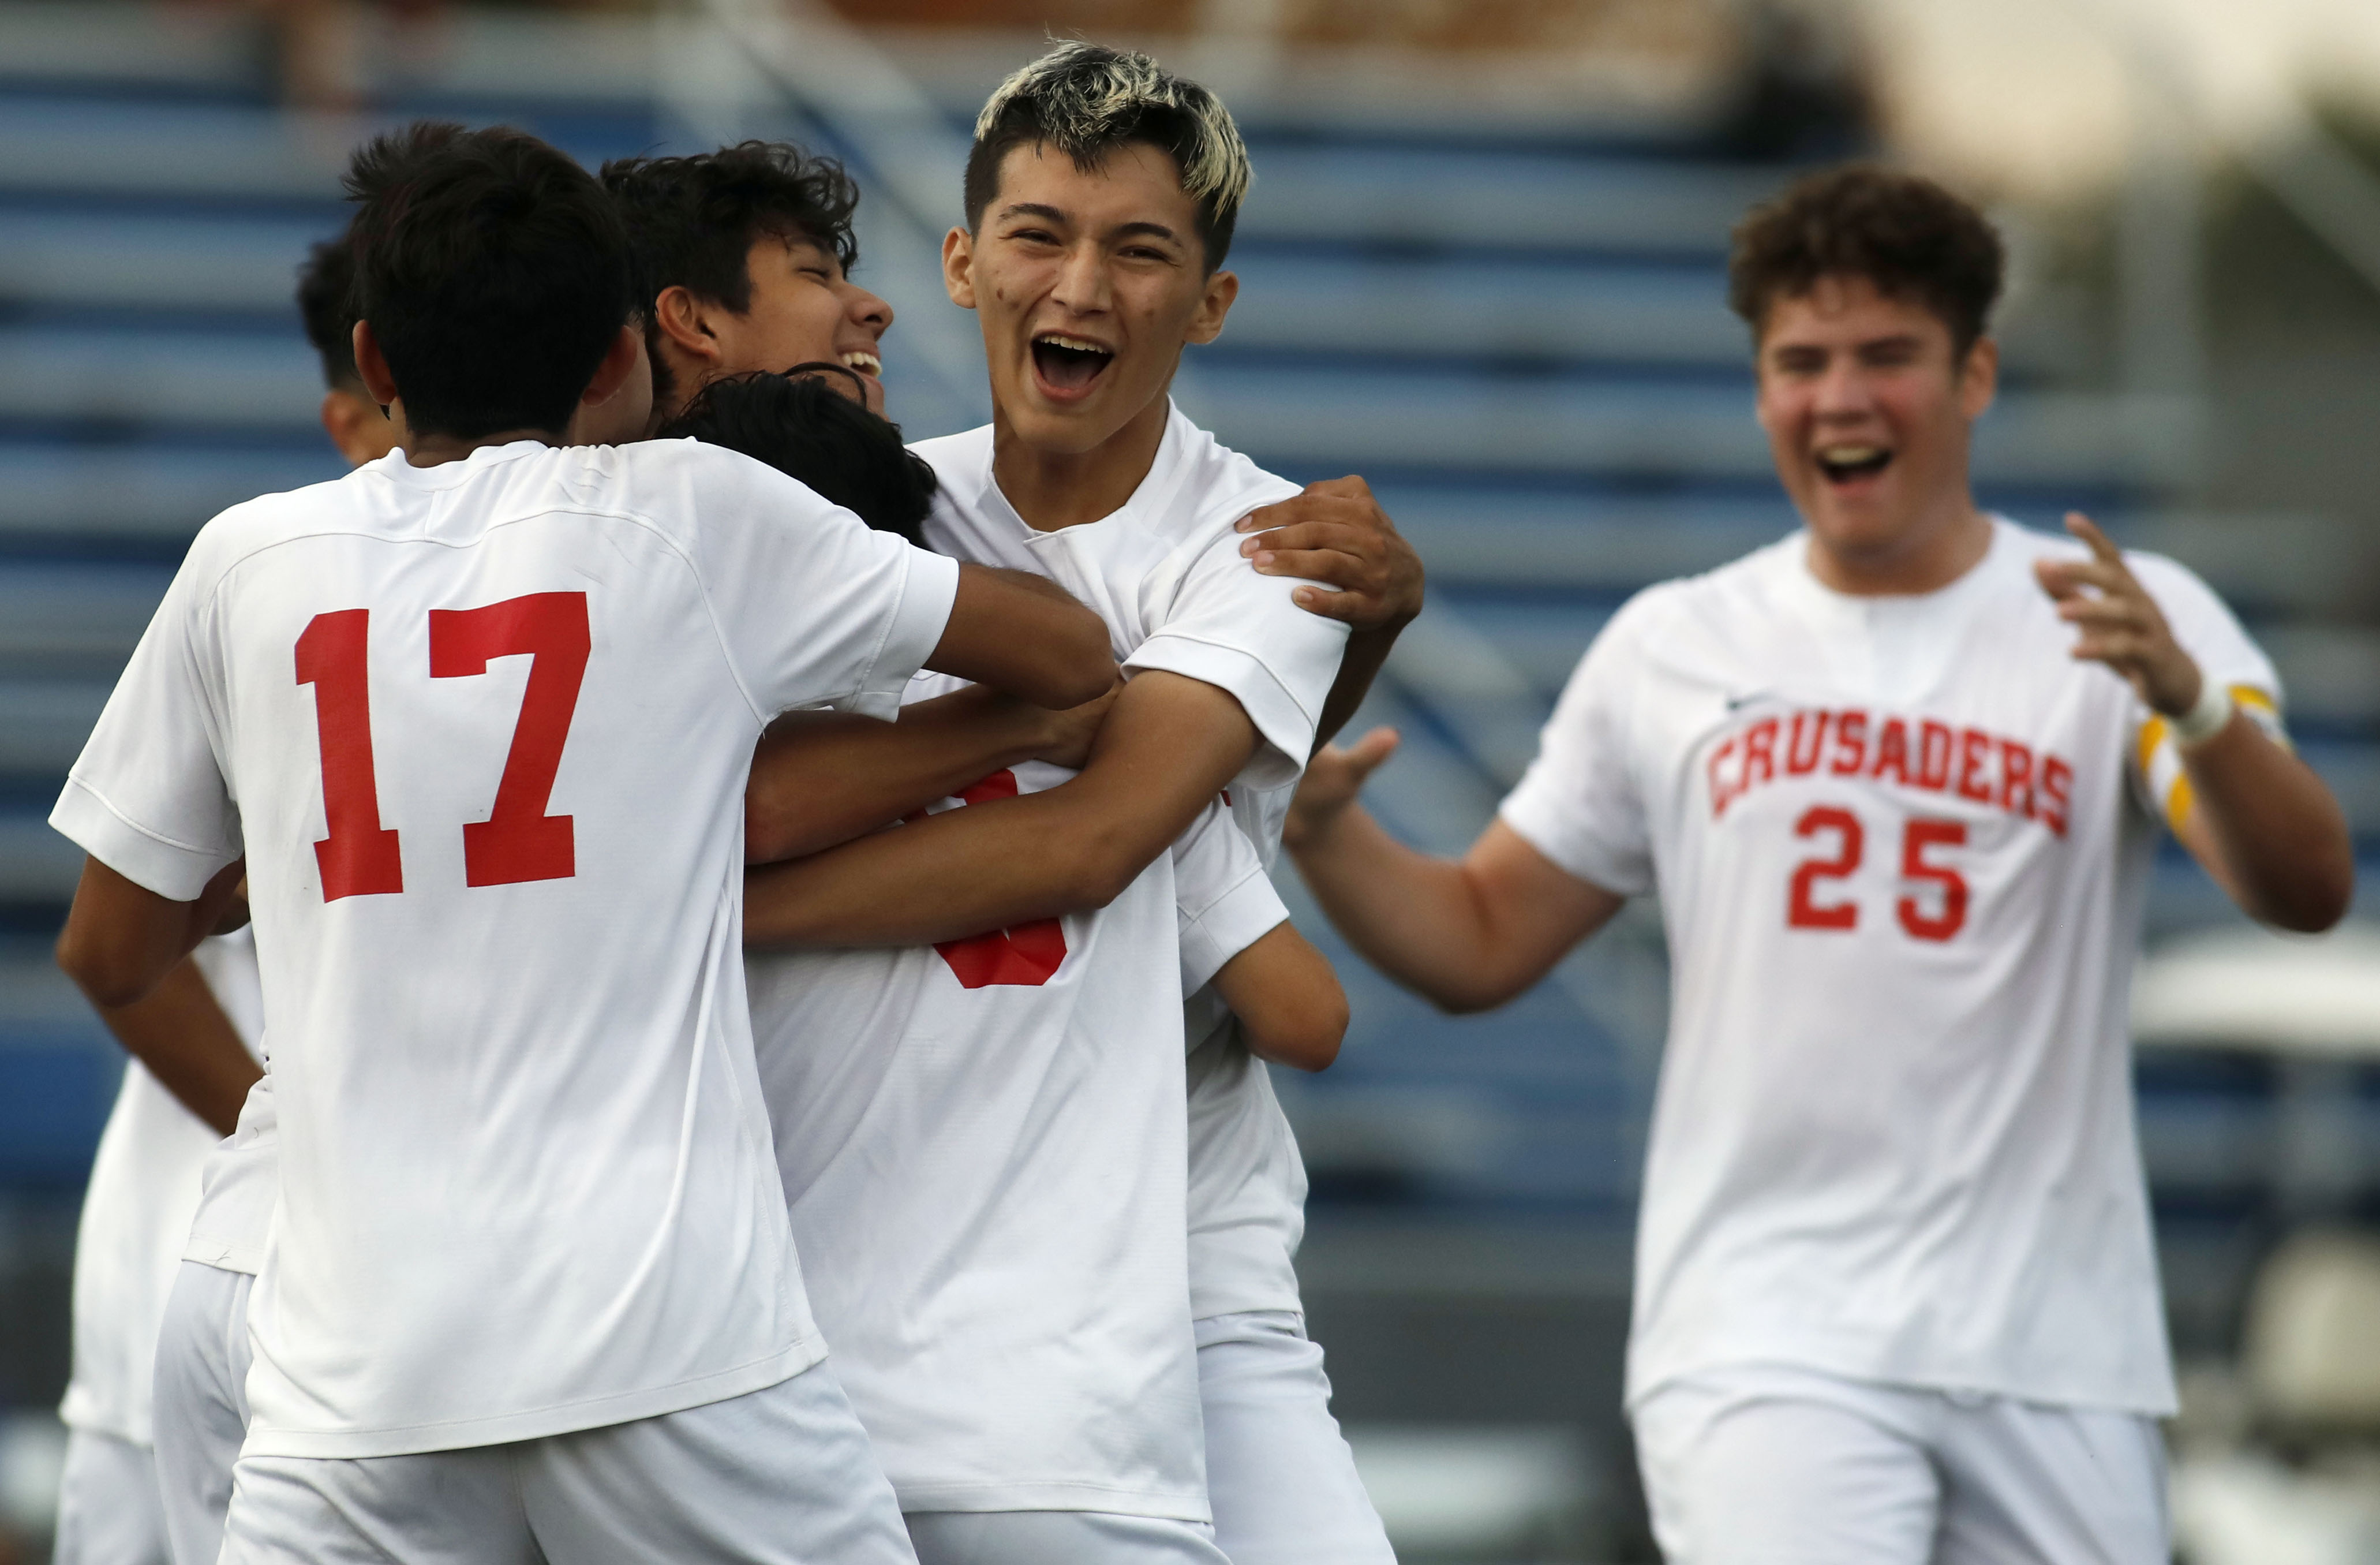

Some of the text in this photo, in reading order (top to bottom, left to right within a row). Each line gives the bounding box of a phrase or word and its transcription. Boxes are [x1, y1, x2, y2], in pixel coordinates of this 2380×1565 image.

[294, 591, 592, 903] 17
[1707, 709, 2073, 841] CRUSADERS
[1786, 806, 1970, 943] 25
